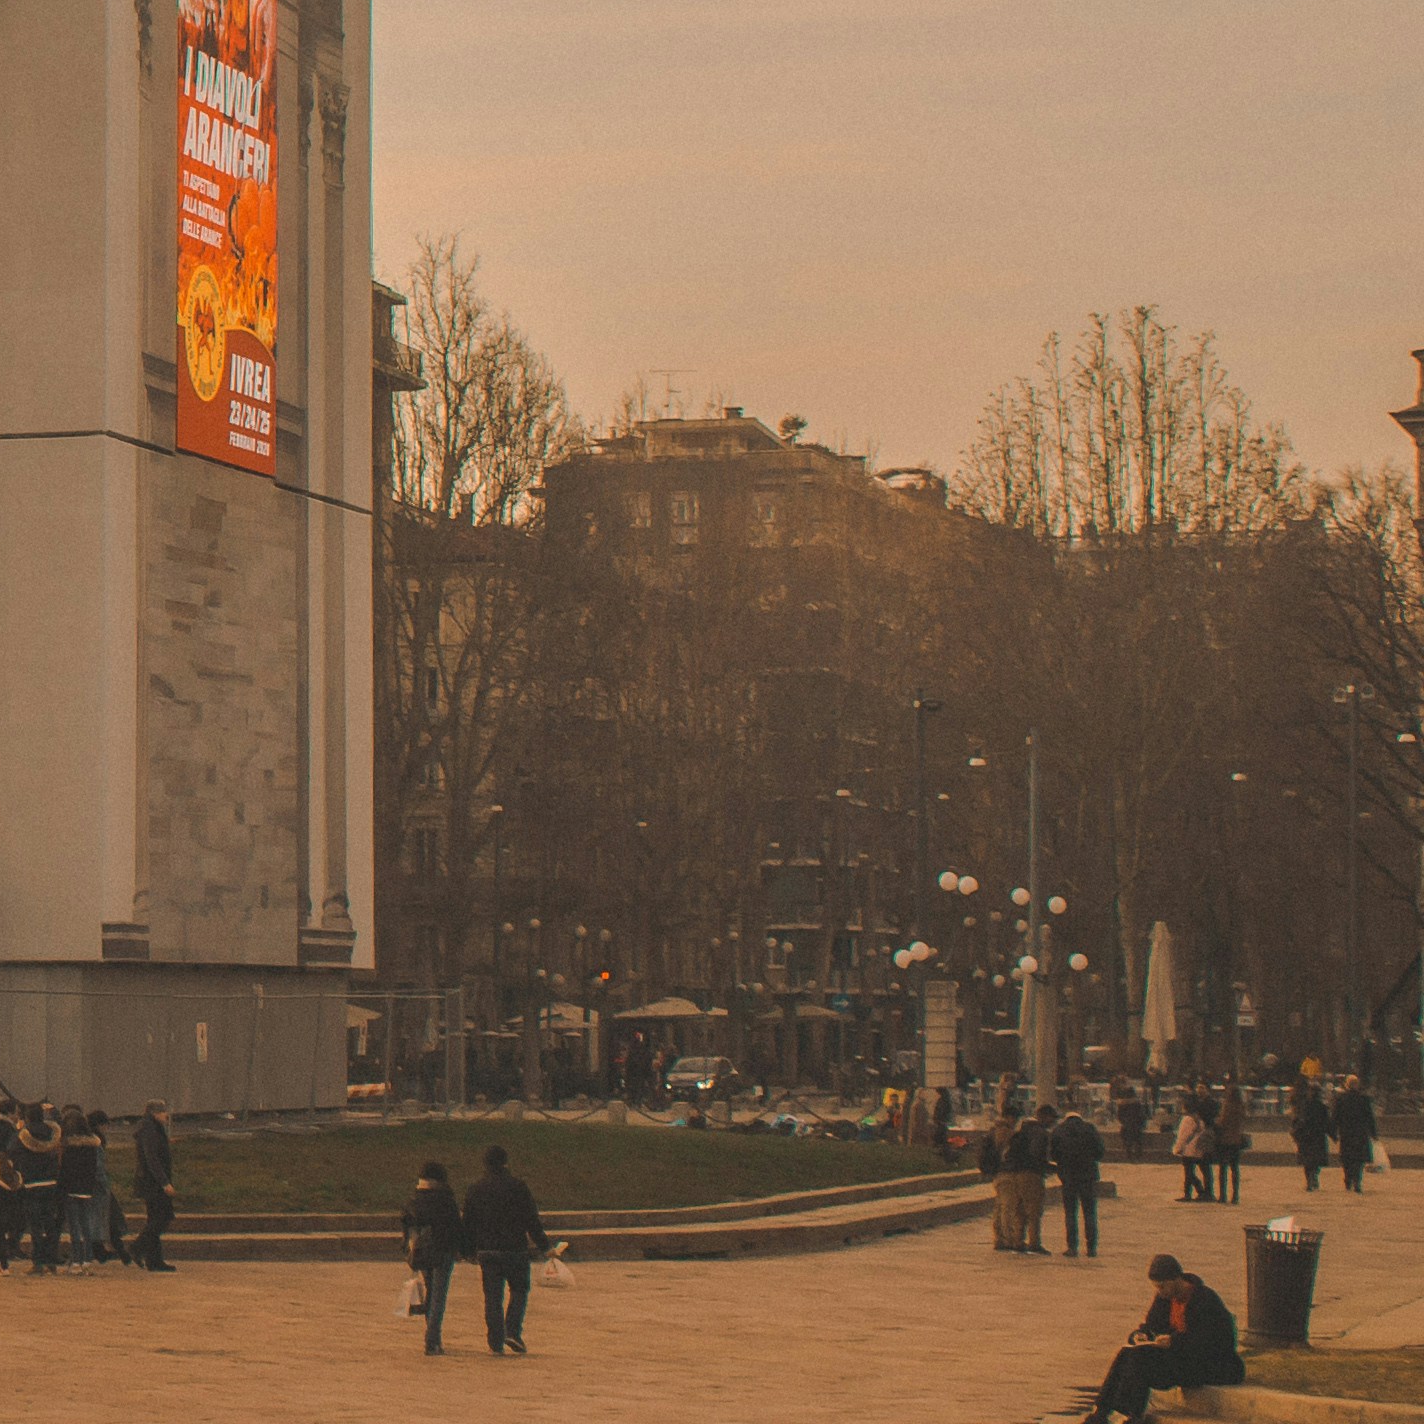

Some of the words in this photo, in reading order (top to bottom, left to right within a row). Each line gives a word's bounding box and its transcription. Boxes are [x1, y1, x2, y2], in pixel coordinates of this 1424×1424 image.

[183, 45, 193, 97] I
[195, 50, 262, 131] DIAVOLI
[183, 106, 271, 186] ARANCERI
[182, 194, 197, 216] ALLA
[182, 218, 200, 240] DELLE
[229, 353, 271, 404] IVREA
[229, 400, 271, 436] 23/24/25
